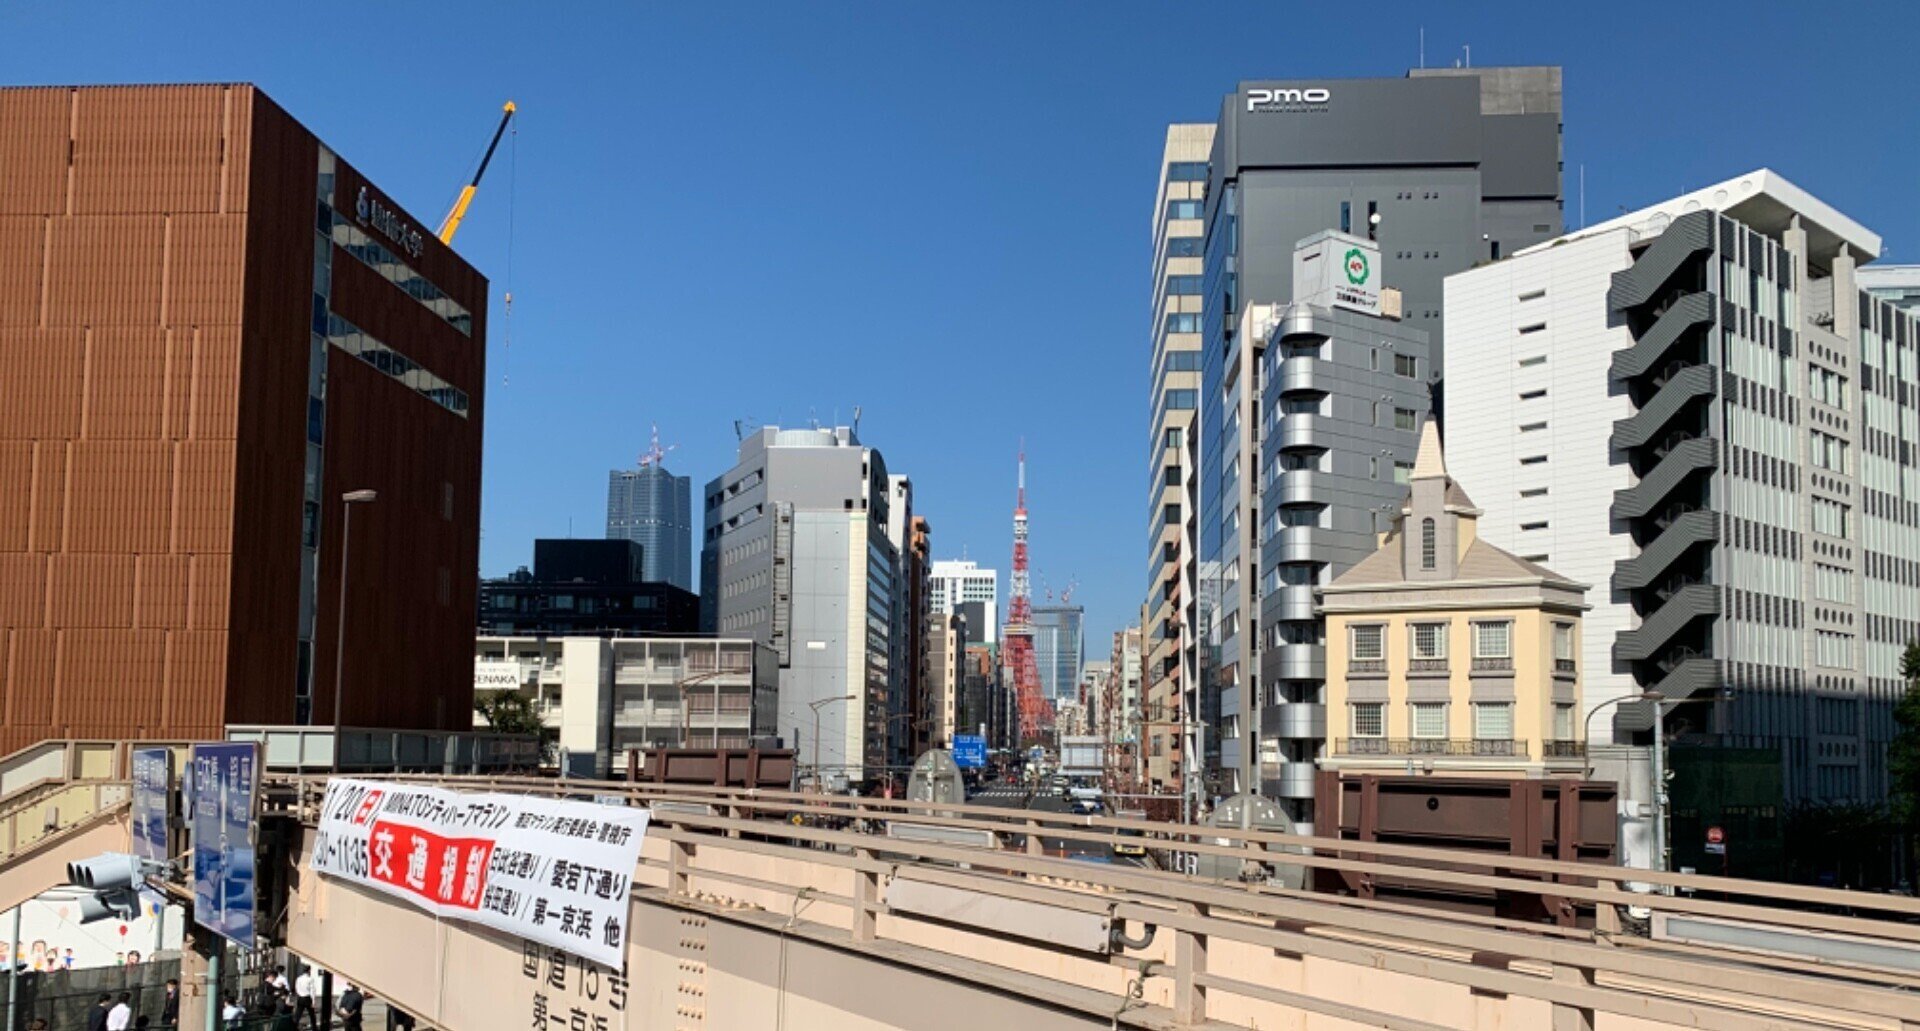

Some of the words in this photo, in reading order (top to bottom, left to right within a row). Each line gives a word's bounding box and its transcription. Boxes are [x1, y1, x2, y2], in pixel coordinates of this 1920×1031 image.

[374, 828, 487, 904] 交通規制
[533, 896, 593, 939] 第一京浜
